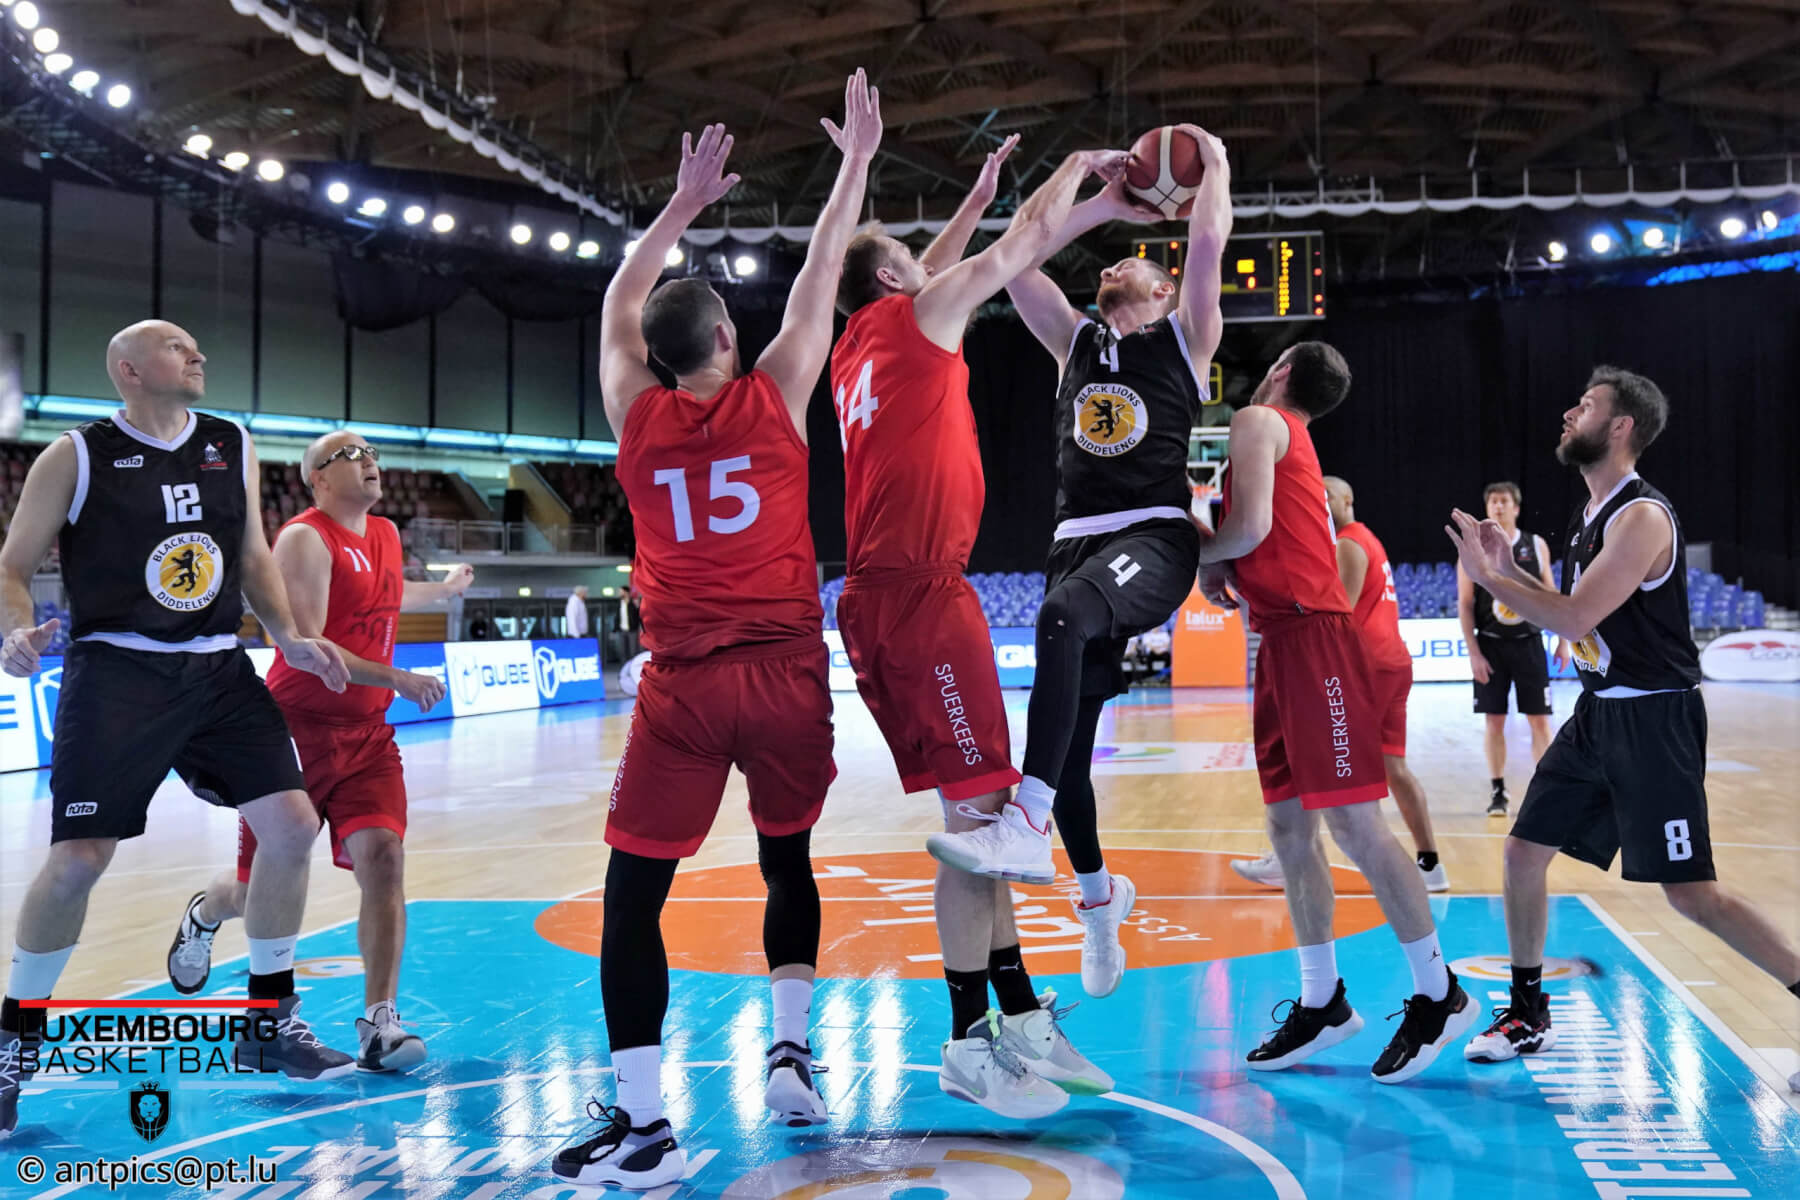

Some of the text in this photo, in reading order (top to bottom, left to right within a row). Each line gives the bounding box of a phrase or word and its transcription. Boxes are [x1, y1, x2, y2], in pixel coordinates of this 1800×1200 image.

[836, 360, 879, 454] 14
[1078, 385, 1141, 407] BLACK LIONS
[1078, 435, 1137, 456] DIDDELENG
[161, 483, 203, 524] 12
[654, 455, 761, 542] 15
[152, 535, 218, 562] BLACK LIONS
[1108, 552, 1142, 587] 4
[156, 590, 216, 609] DIDDELENG
[481, 663, 530, 687] QUBE
[556, 655, 600, 683] QUBE
[935, 663, 982, 766] SPUERKEESS
[1324, 676, 1352, 778] SPUERKEESS
[1664, 819, 1692, 862] 8
